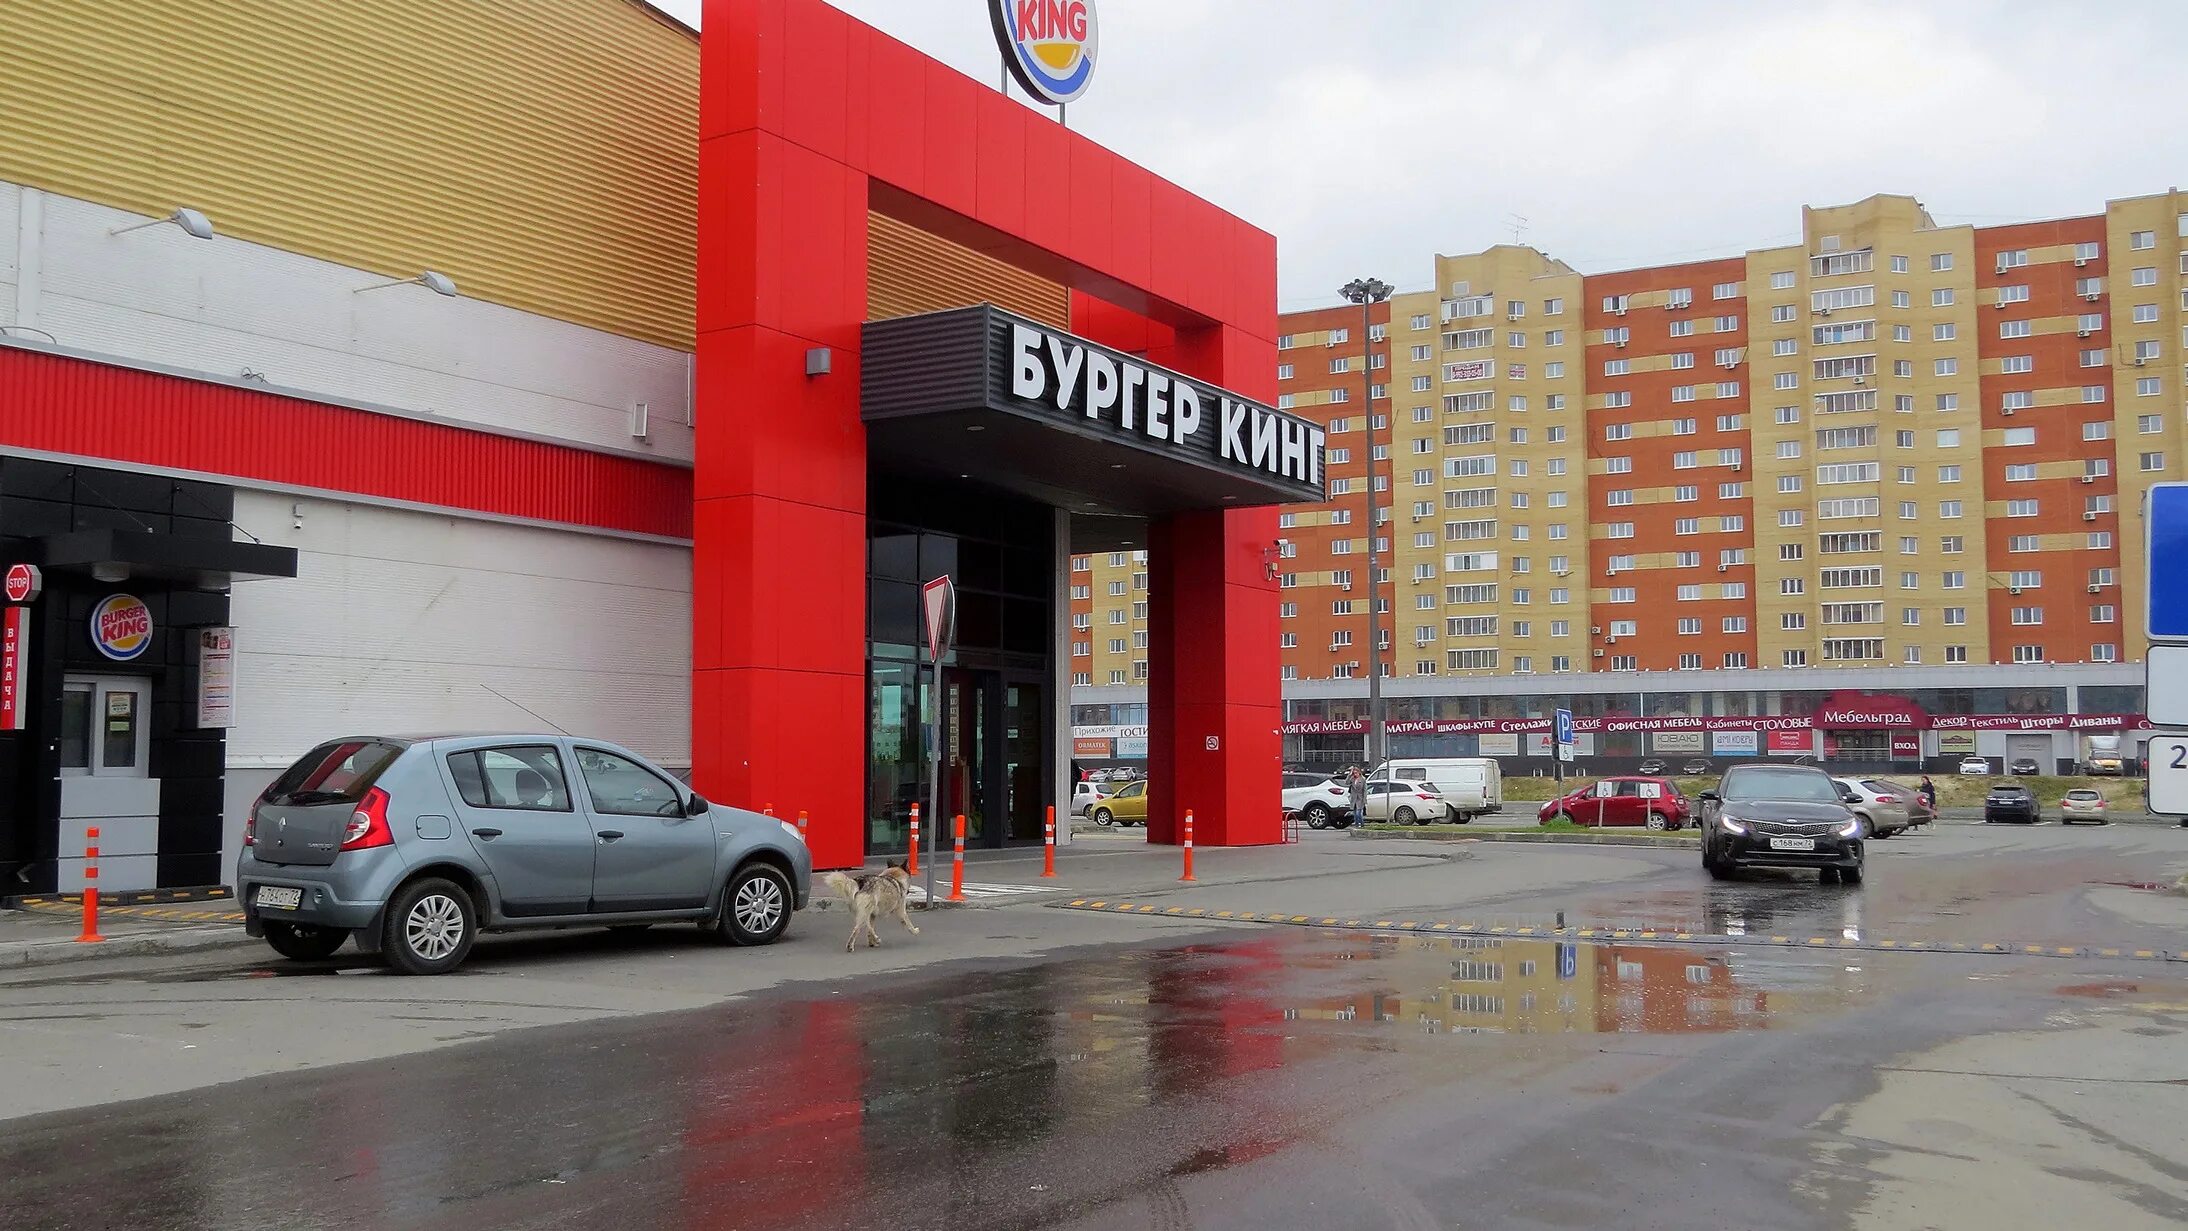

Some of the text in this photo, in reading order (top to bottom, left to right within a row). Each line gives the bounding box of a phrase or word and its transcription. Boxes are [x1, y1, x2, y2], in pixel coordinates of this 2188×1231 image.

[1018, 0, 1087, 42] KING
[1012, 323, 1325, 485] БУРГЕР КИНГ
[8, 577, 28, 589] STOP
[101, 606, 147, 626] BURGER
[102, 617, 148, 644] KING
[4, 628, 15, 710] ВЫДАЧА
[1571, 718, 1602, 729] ТСКИЕ
[1706, 719, 1752, 729] Кабинеты
[1753, 717, 1812, 731] СТОЛОВЫЕ
[1824, 710, 1912, 725] Мебельград
[1932, 716, 1968, 728] Декор
[1969, 716, 2018, 728] Текстиль
[2020, 716, 2064, 729] Шторы
[2068, 715, 2122, 728] Диваны
[1075, 725, 1116, 737] Прихожие
[1281, 720, 1362, 734] МЯГКАЯ МЕБЕЛЬ
[1386, 721, 1434, 734] МАТРАСЫ
[1437, 720, 1496, 733] ШКАФЫ-КУПЕ
[1501, 719, 1552, 732] Стеллажи
[1561, 713, 1570, 740] P
[1607, 718, 1702, 731] ОФИСНАЯ МЕБЕЛЬ
[1657, 734, 1699, 743] ЮВАЮ
[1894, 742, 1918, 750] ВХОД
[2170, 745, 2187, 769] 2
